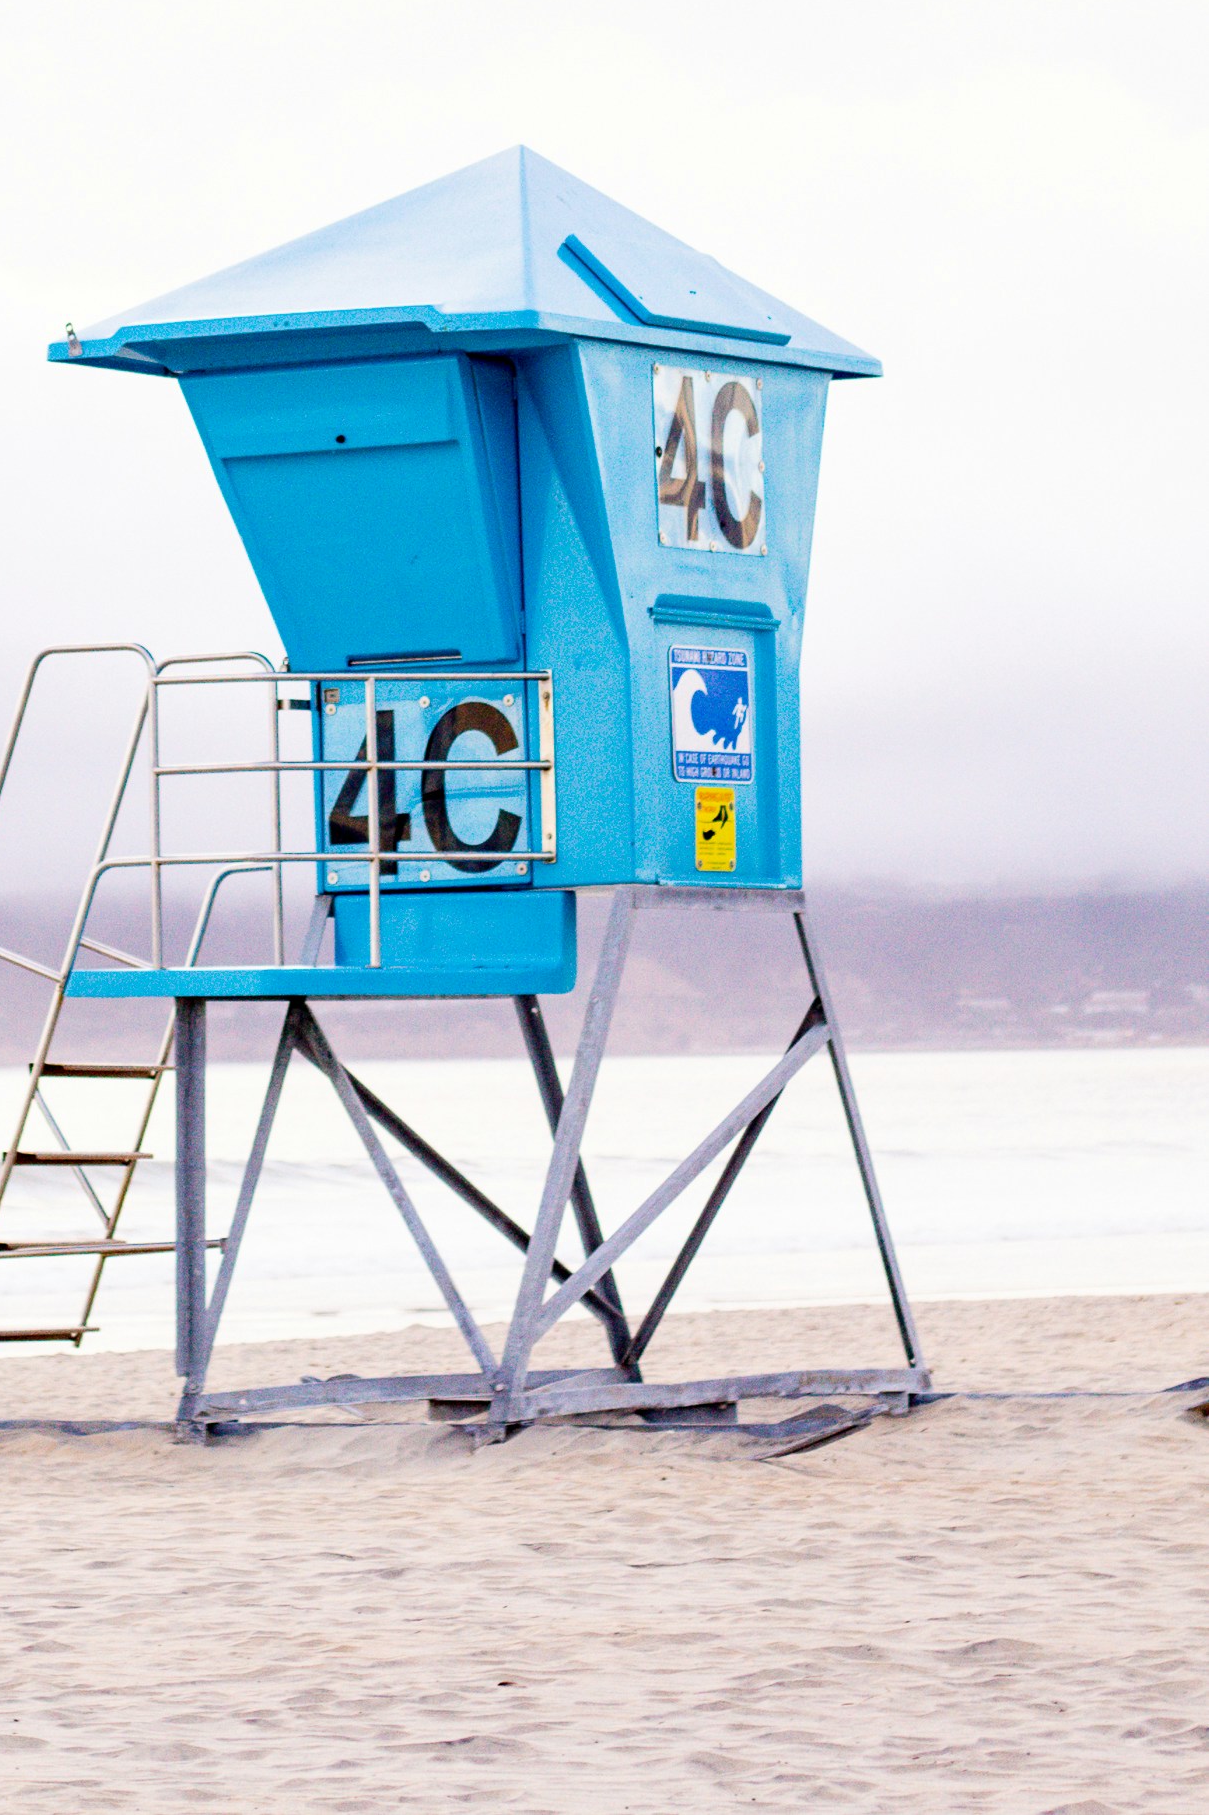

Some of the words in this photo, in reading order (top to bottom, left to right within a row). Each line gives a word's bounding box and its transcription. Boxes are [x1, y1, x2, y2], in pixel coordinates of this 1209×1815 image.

[658, 376, 762, 549] 4C
[673, 649, 701, 663] TSUNAMI
[702, 651, 727, 665] HZARD
[728, 652, 745, 666] ZONE
[329, 701, 522, 875] 4C
